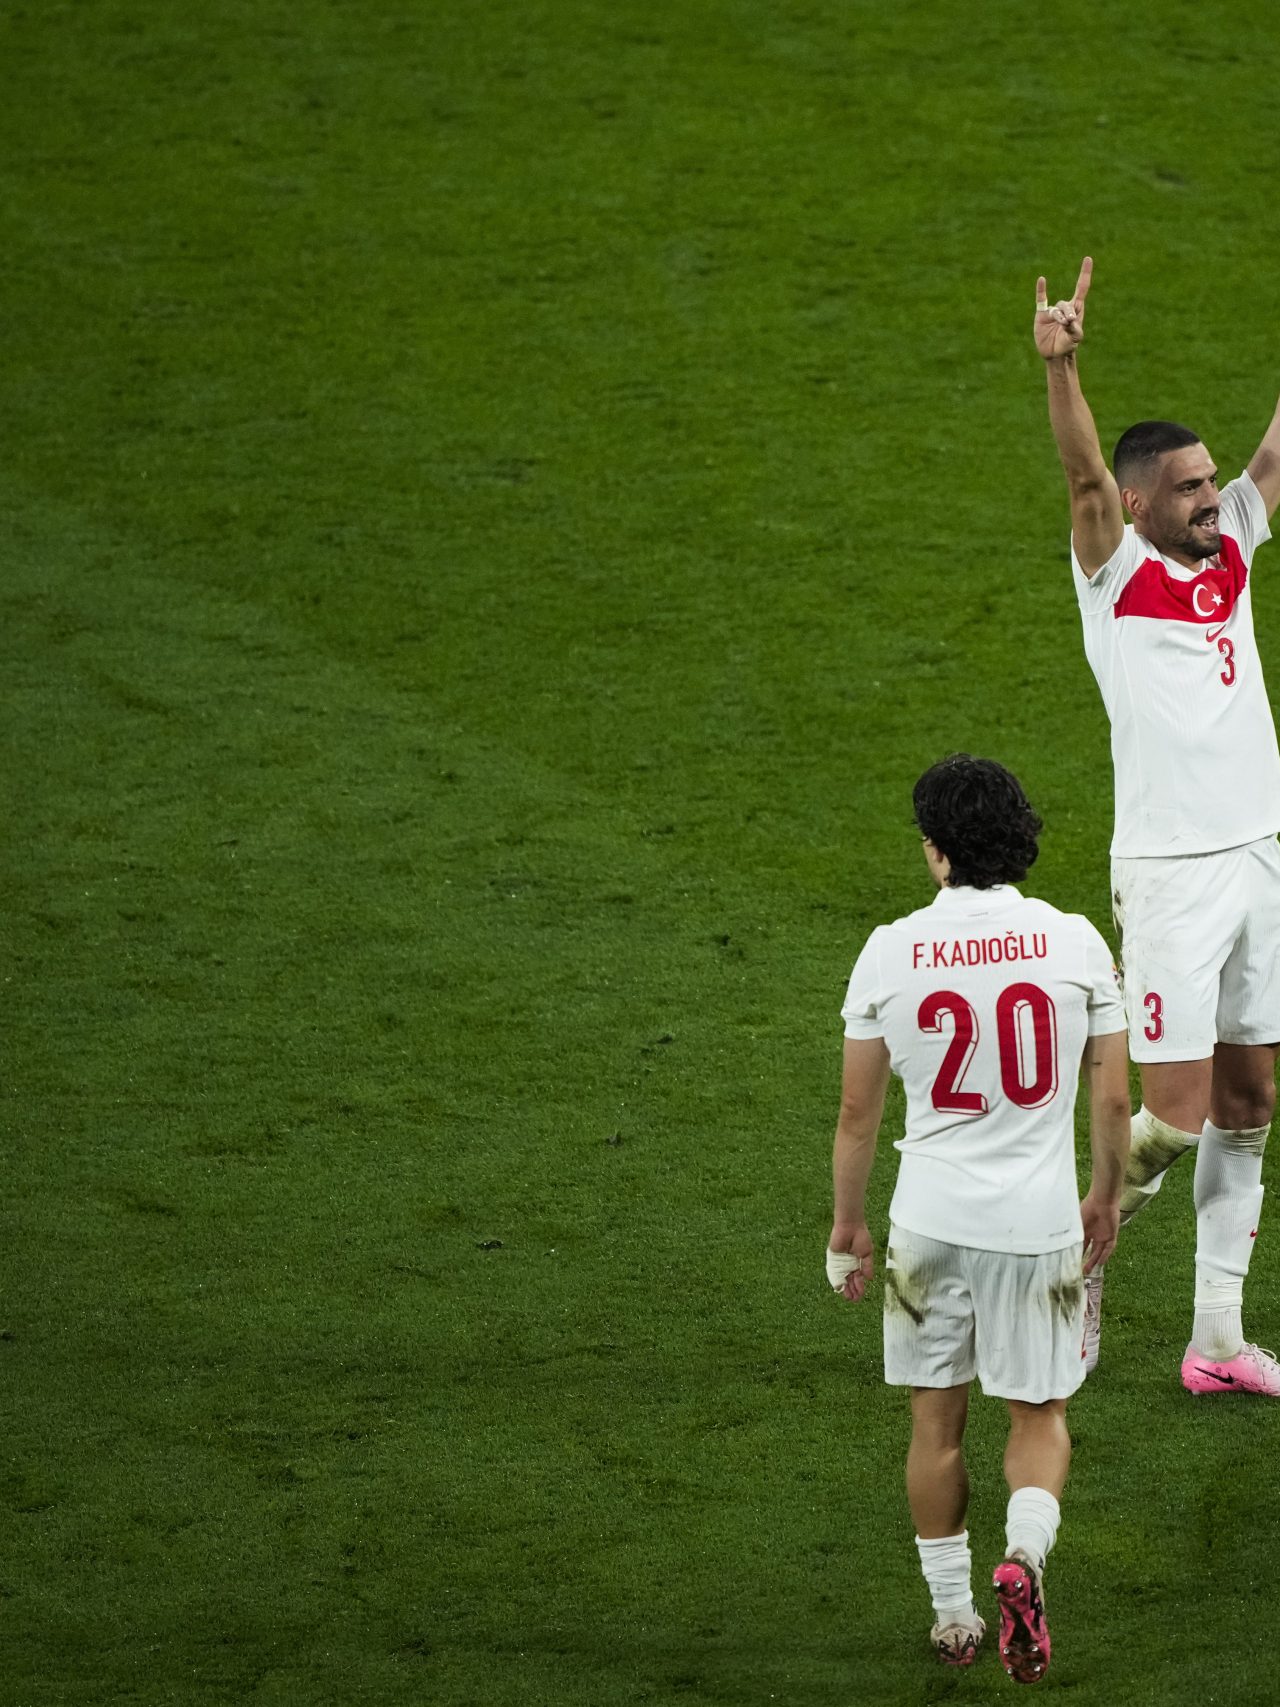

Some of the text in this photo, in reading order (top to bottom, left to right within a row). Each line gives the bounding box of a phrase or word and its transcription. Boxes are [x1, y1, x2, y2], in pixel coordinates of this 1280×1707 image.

[1217, 637, 1237, 687] 3
[913, 931, 1047, 969] F.KADIOĞLU
[1143, 991, 1165, 1043] 3
[917, 982, 1058, 1116] 20
